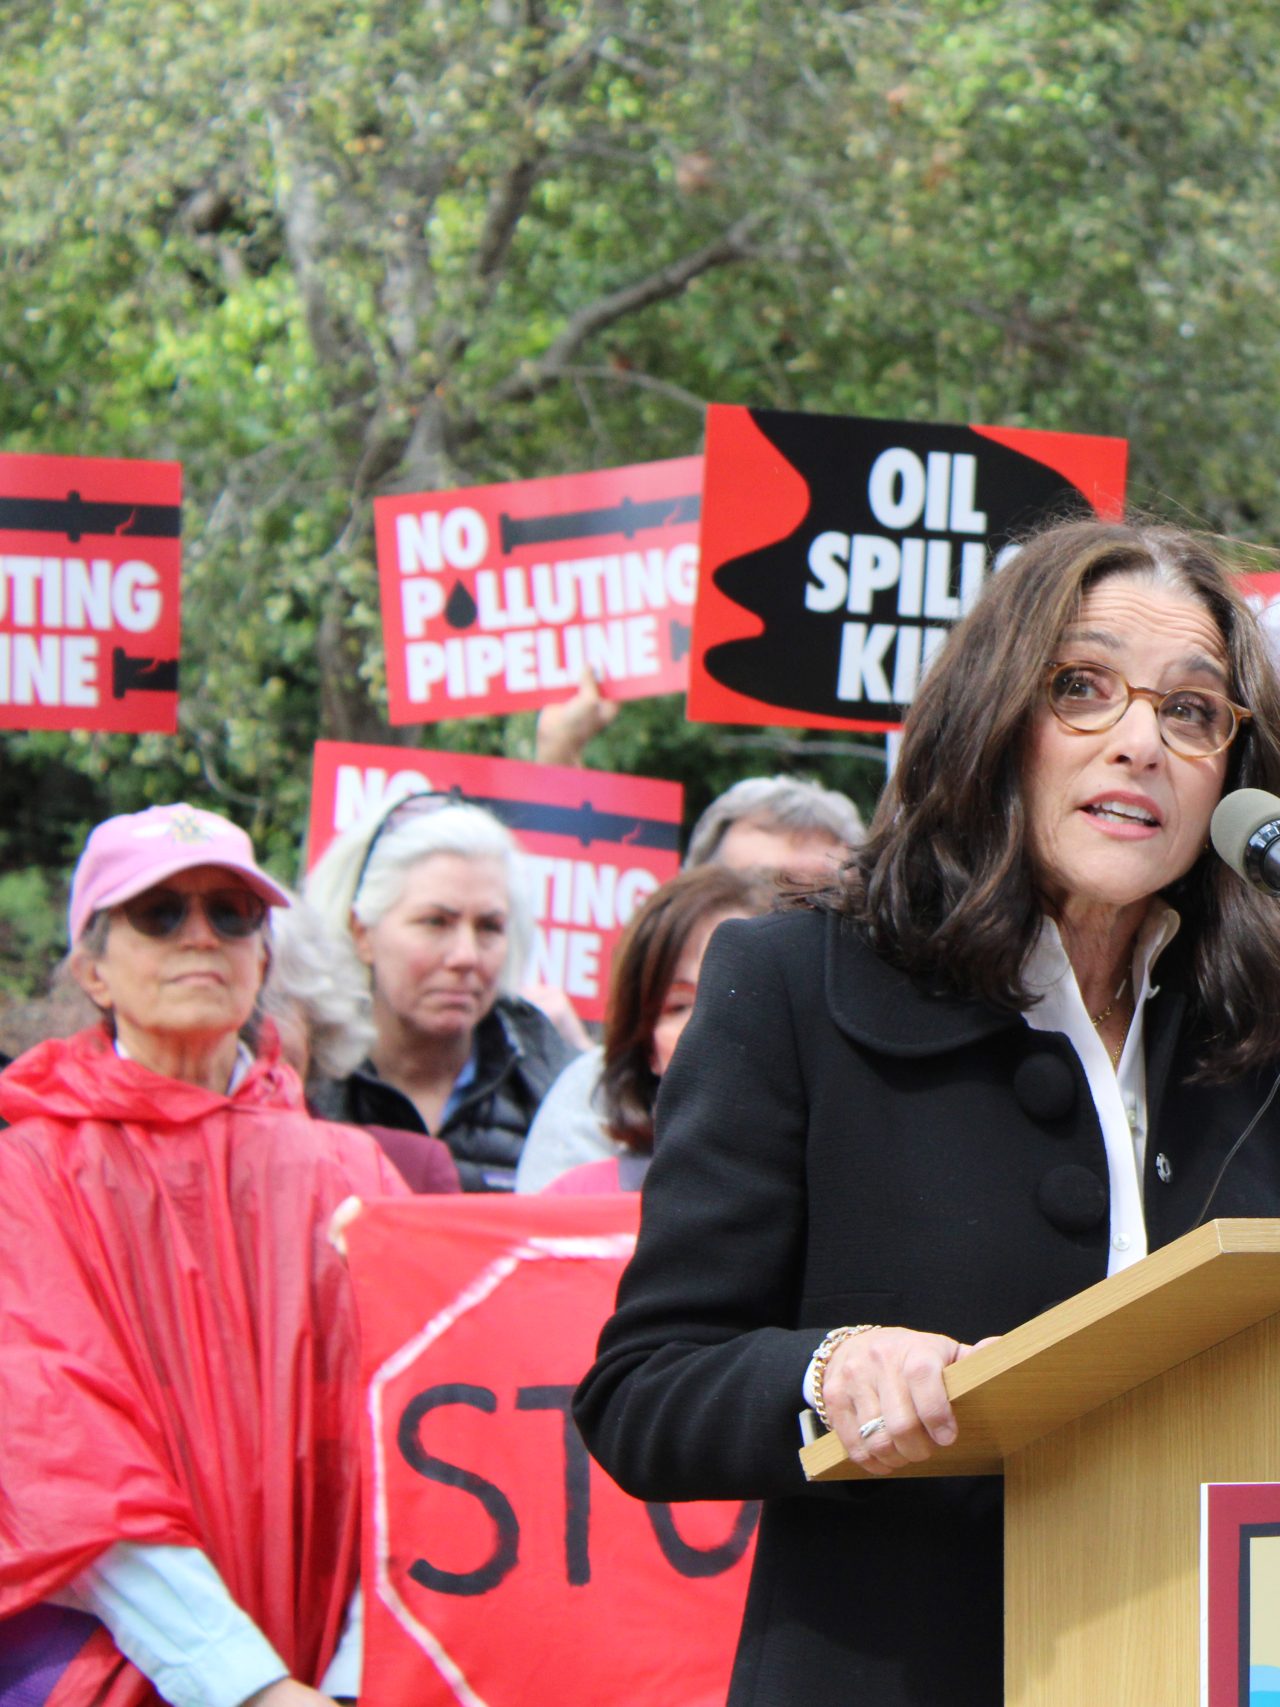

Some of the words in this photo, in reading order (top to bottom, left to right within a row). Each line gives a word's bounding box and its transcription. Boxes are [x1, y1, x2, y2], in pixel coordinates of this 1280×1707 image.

[868, 447, 987, 535] OIL
[396, 507, 488, 574] NO
[804, 530, 1024, 620] SPILL
[0, 555, 163, 634] TING
[405, 614, 659, 703] PIPELINE
